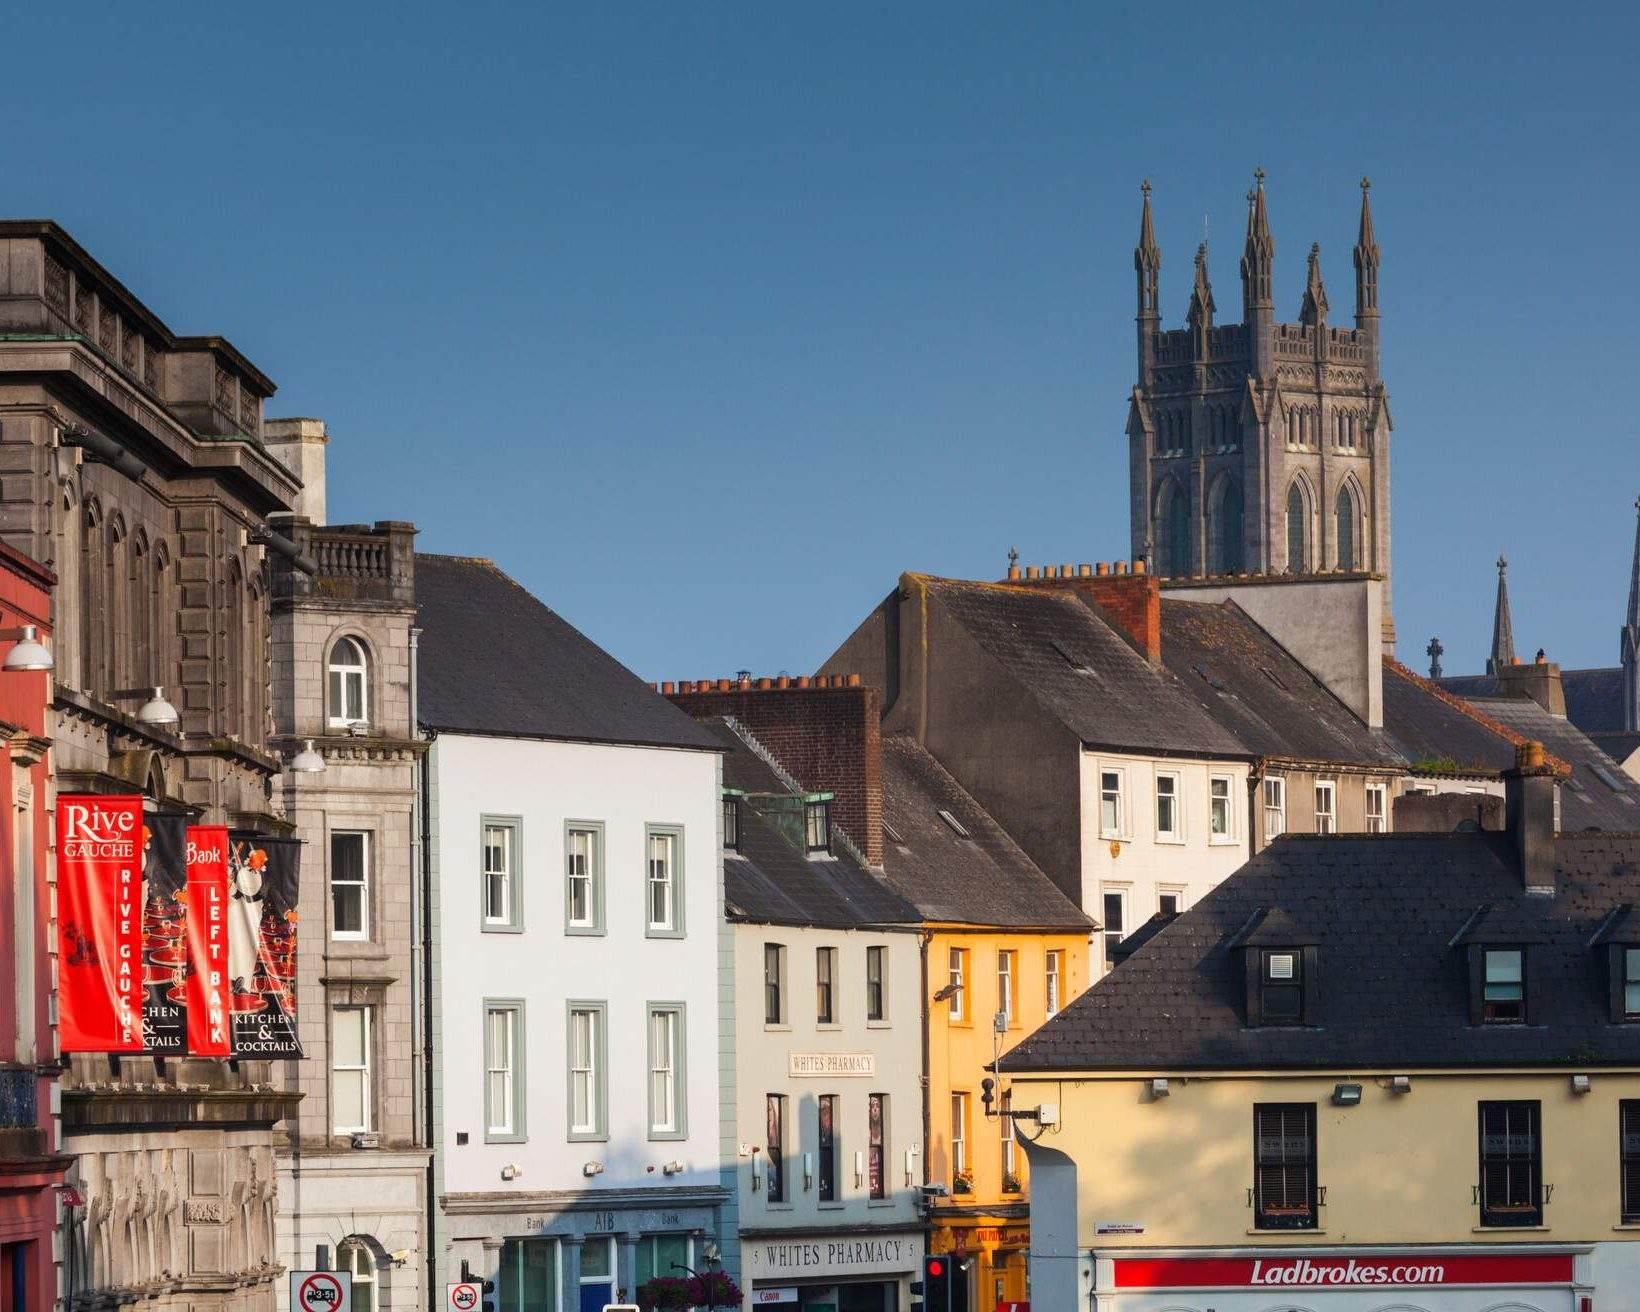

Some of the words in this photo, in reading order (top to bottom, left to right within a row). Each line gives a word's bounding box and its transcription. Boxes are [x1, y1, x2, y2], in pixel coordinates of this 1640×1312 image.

[64, 805, 134, 842] Rive
[64, 843, 134, 857] GAUCHE
[187, 842, 221, 865] Bank
[120, 869, 131, 935] RIVE
[209, 887, 221, 959] LEFT
[120, 944, 132, 1043] GAUCHE
[210, 972, 223, 1043] BANK
[235, 1014, 291, 1024] KITCHEN
[258, 1025, 274, 1040] &
[235, 1041, 296, 1052] COCKTAILS
[793, 1056, 824, 1071] WHITES
[827, 1056, 872, 1071] PHARMACY
[526, 1217, 544, 1229] Bank
[595, 1213, 614, 1230] AIB
[767, 1244, 820, 1267] WHITES
[828, 1240, 901, 1265] PHARMACY
[1250, 1259, 1445, 1285] Ladbrokes.com
